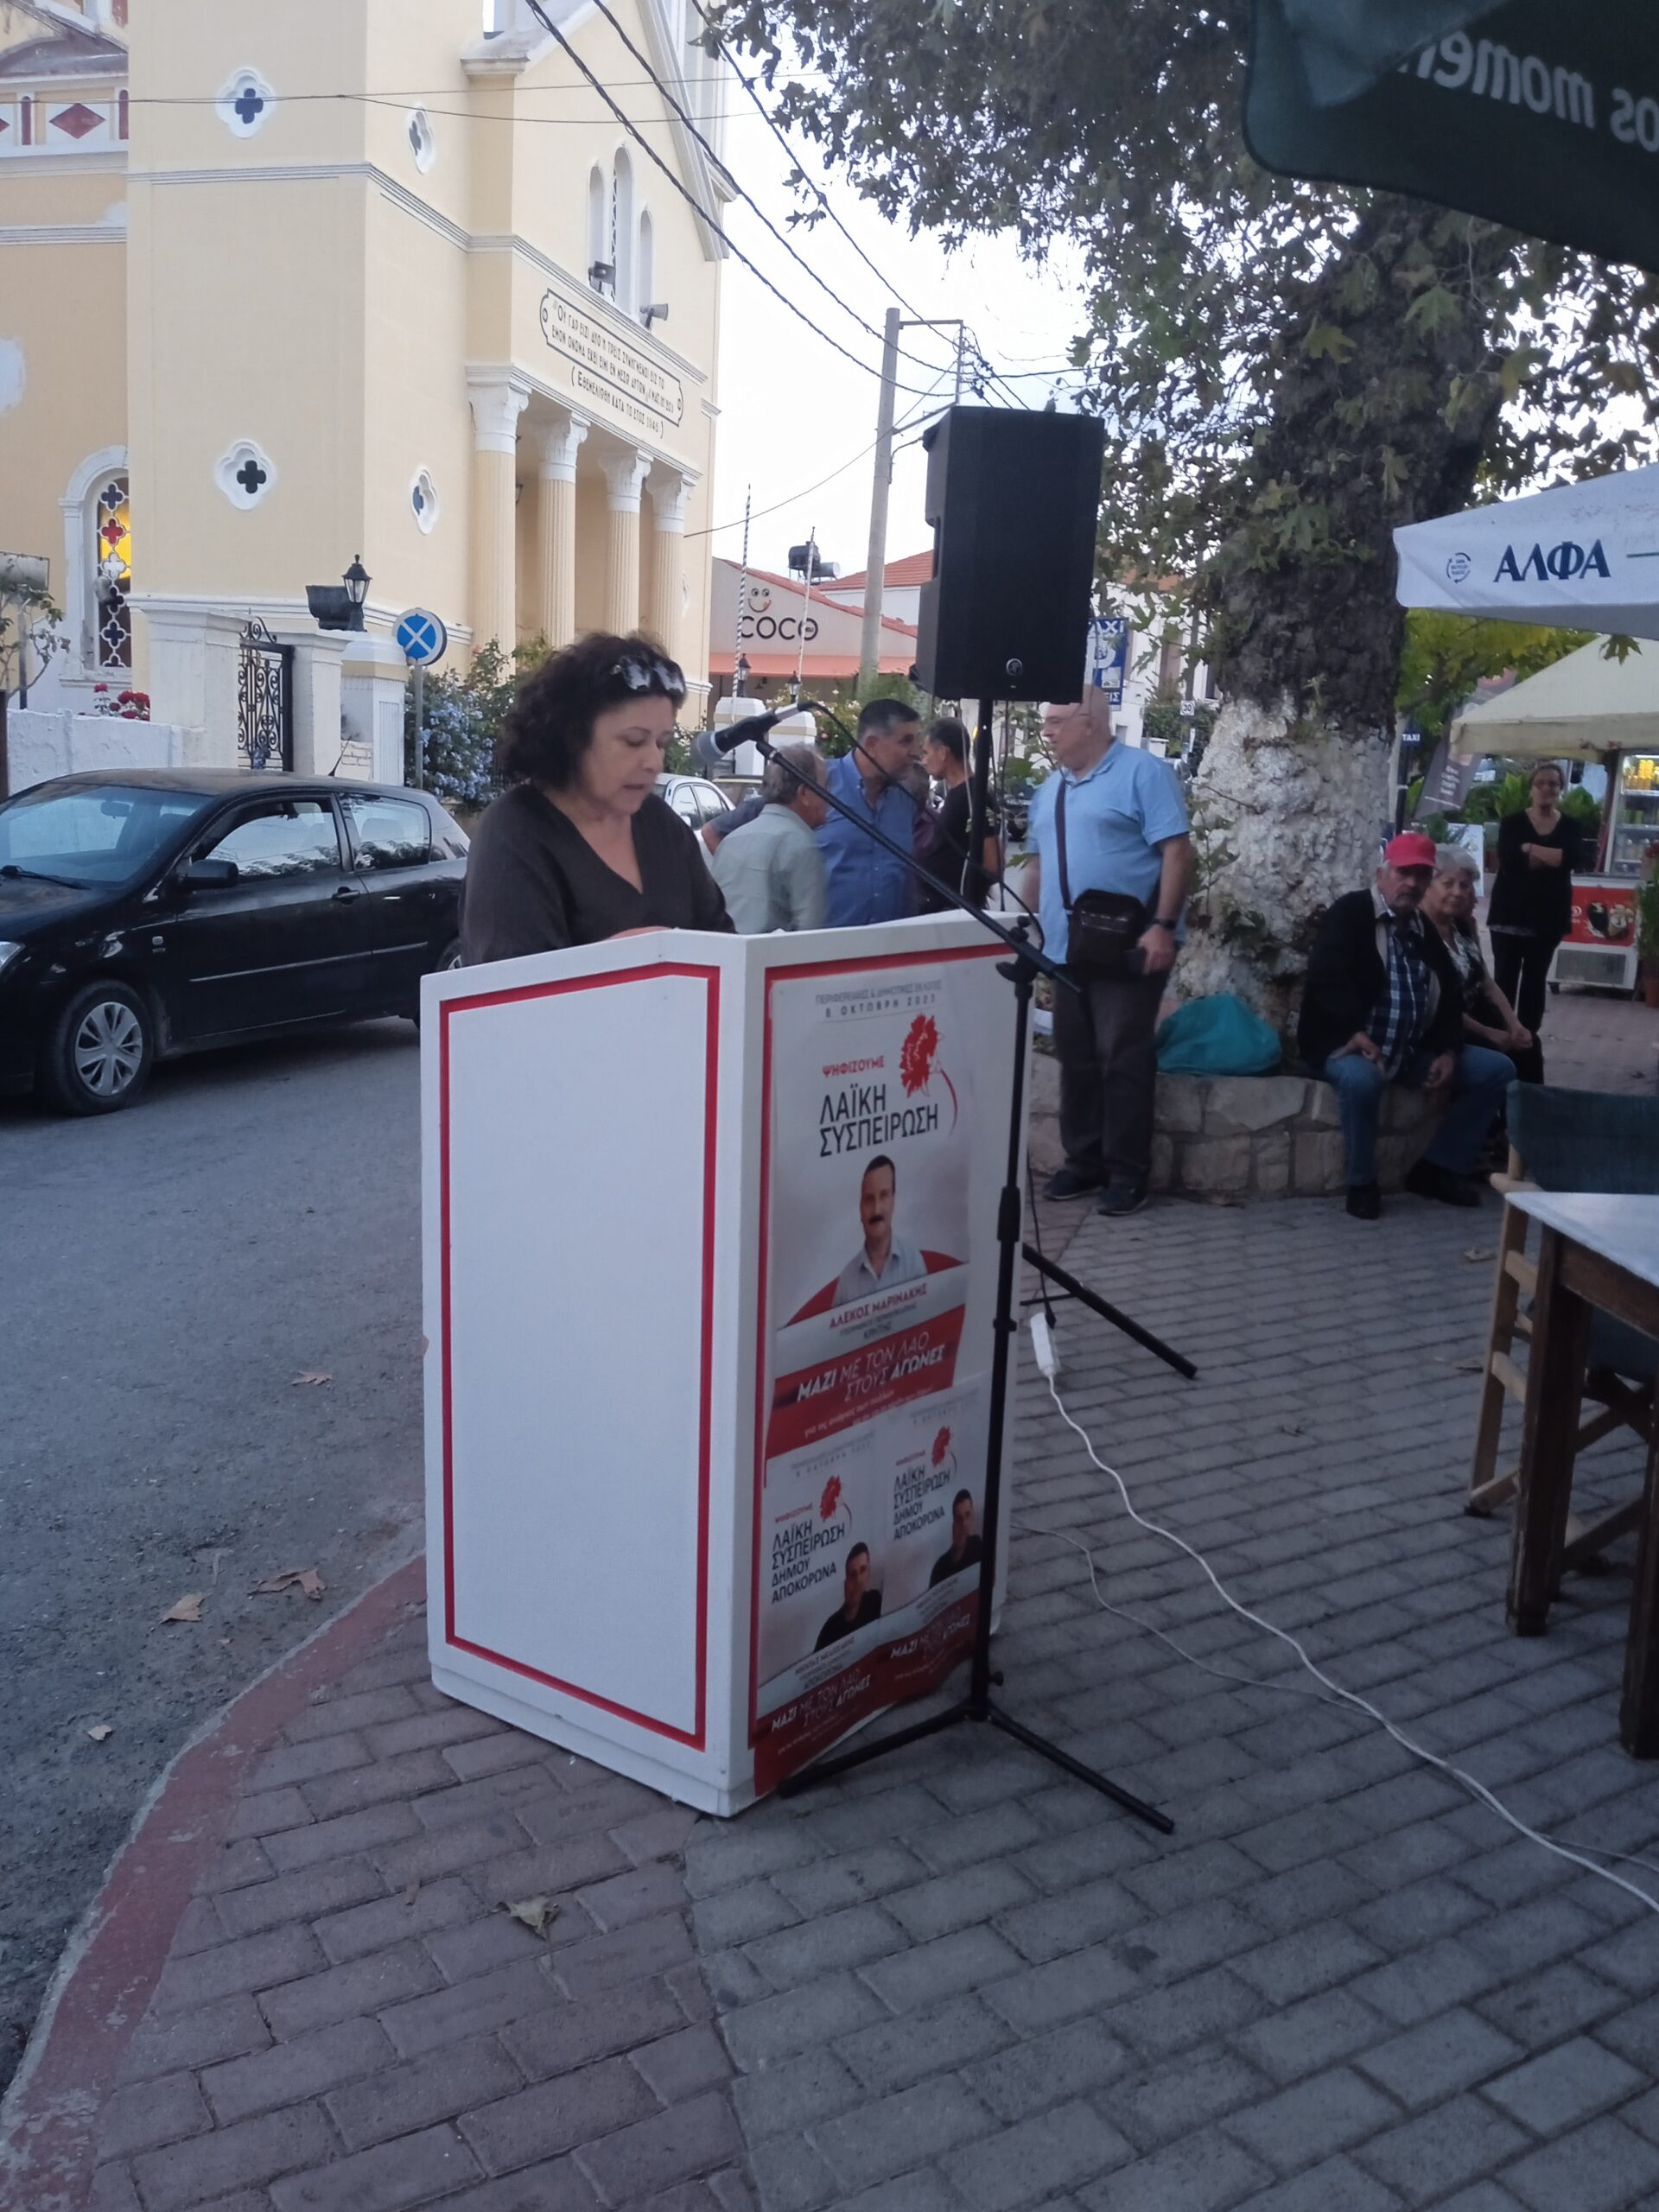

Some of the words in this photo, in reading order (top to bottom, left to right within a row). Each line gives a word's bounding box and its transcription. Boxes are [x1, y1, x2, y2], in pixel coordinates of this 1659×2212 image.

[1493, 537, 1611, 582] ΑΛΦΑ
[1402, 733, 1421, 741] TAXI
[823, 1055, 885, 1077] ΨΗΦΙΖΟΥΜΕ
[820, 1083, 886, 1125] ΛΑΪΚΗ
[820, 1103, 938, 1157] ΣΥΣΠΕΙΡΩΣΗ
[830, 1304, 870, 1329] ΑΛΕΚΟΣ
[872, 1283, 928, 1313] ΜΑΡΙΝΑΚΗΣ
[797, 1370, 836, 1402] ΜΑΖΙ
[839, 1357, 861, 1382] ΜΕ
[866, 1344, 895, 1370] ΤΟΝ
[898, 1332, 930, 1357] ΛΑΟ
[844, 1366, 889, 1402] ΣΤΟΥΣ
[891, 1344, 945, 1381] ΑΓΩΝΕΣ
[893, 1468, 950, 1510] ΣΥΣΠΕΙΡΩΣΗ
[893, 1500, 923, 1526] ΔΗΜΟΥ
[893, 1505, 945, 1541] ΑΠΟΚΟΡΩΝΑ
[772, 1518, 813, 1551] ΛΑΪΚΗ
[772, 1522, 845, 1570] ΣΥΣΠΕΙΡΩΣΗ
[772, 1557, 810, 1587] ΔΗΜΟΥ
[772, 1561, 837, 1605] ΑΠΟΚΟΡΩΝΑ
[772, 1706, 798, 1733] ΜΑΖΙ
